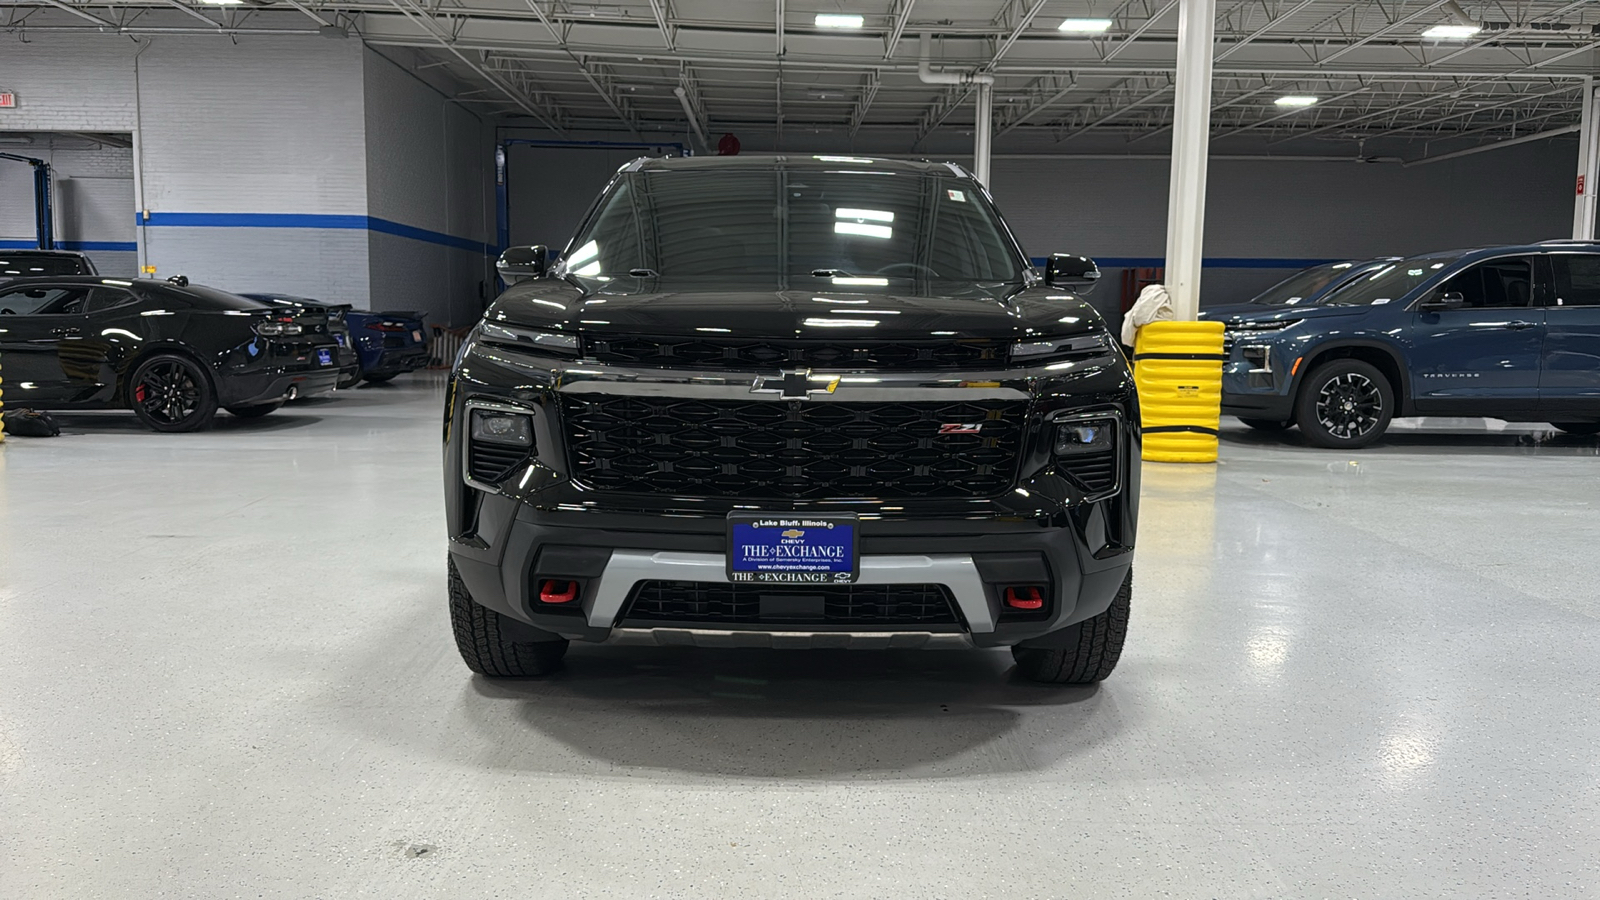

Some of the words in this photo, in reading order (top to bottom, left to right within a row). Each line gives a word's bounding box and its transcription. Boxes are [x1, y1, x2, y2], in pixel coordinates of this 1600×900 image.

[938, 423, 983, 434] Z71
[742, 545, 769, 556] THE
[776, 545, 844, 558] EXCHANGE
[732, 573, 754, 581] THE
[765, 573, 828, 582] EXCHANGE
